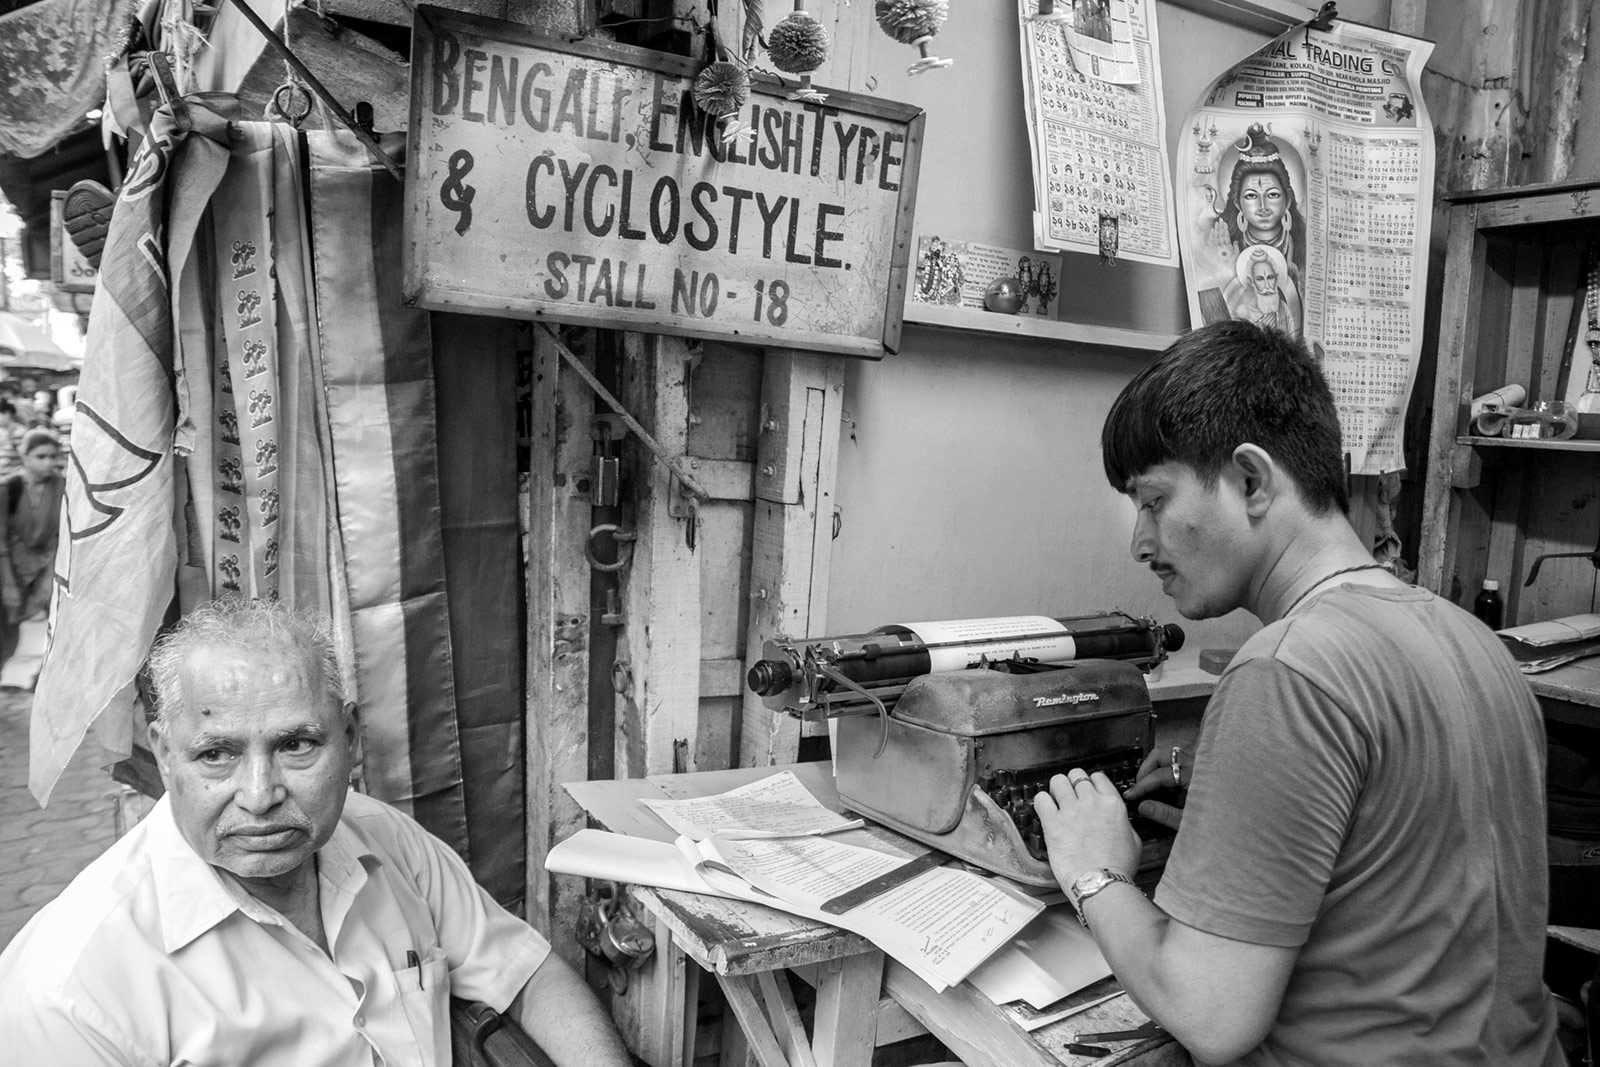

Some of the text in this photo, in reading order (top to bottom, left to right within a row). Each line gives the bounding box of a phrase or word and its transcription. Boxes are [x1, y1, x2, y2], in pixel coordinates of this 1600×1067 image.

[1290, 62, 1314, 71] KOLKATA
[1349, 75, 1366, 84] KHOLA
[1302, 42, 1373, 74] TRADING
[440, 149, 851, 271] & CYCLOSTYLE.
[543, 251, 656, 311] STALL
[1033, 692, 1099, 708] Remington
